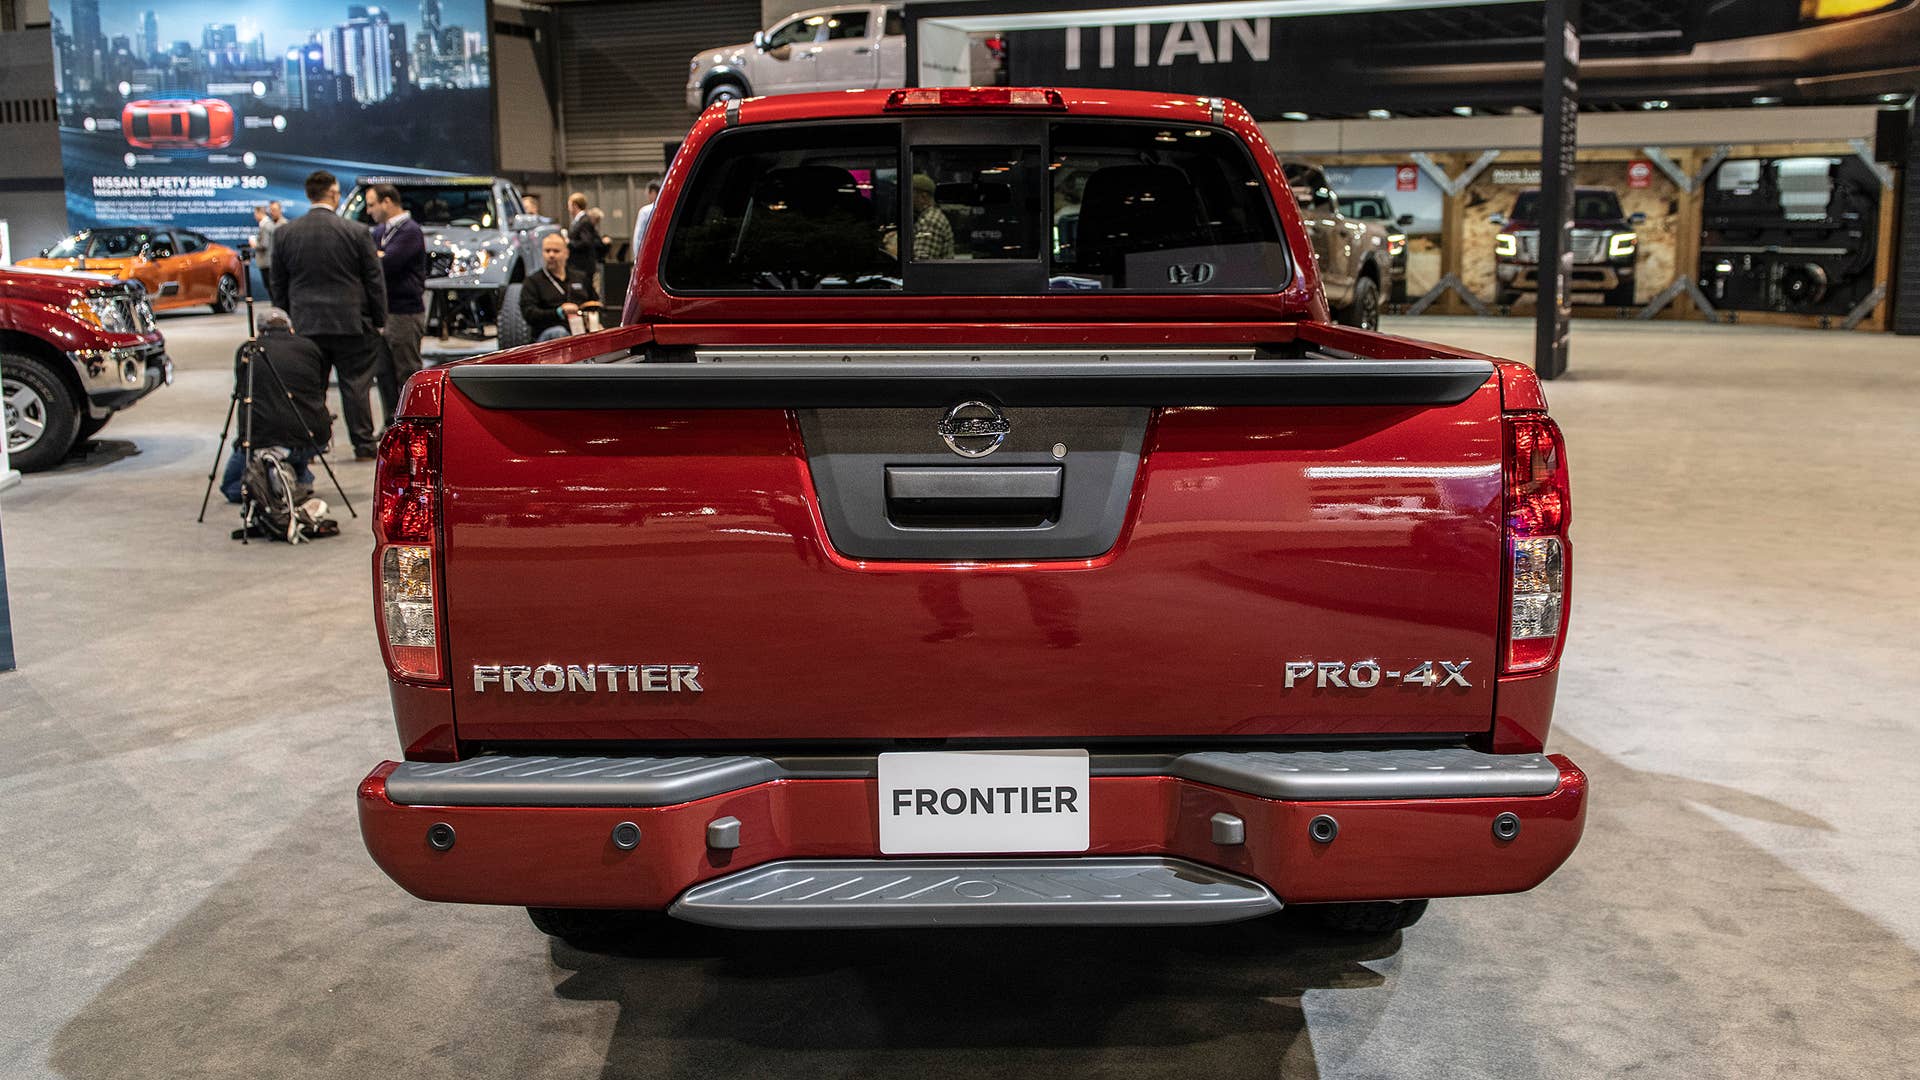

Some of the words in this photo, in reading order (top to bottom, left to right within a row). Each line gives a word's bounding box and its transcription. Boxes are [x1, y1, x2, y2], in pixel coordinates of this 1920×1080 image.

[93, 176, 139, 188] NISSAN
[140, 176, 187, 188] SAFETY
[241, 176, 267, 189] 360
[939, 419, 1009, 434] NISSAN
[473, 664, 704, 692] FRONTIER
[1284, 660, 1473, 688] PRO-4X
[892, 786, 1078, 816] FRONTIER
